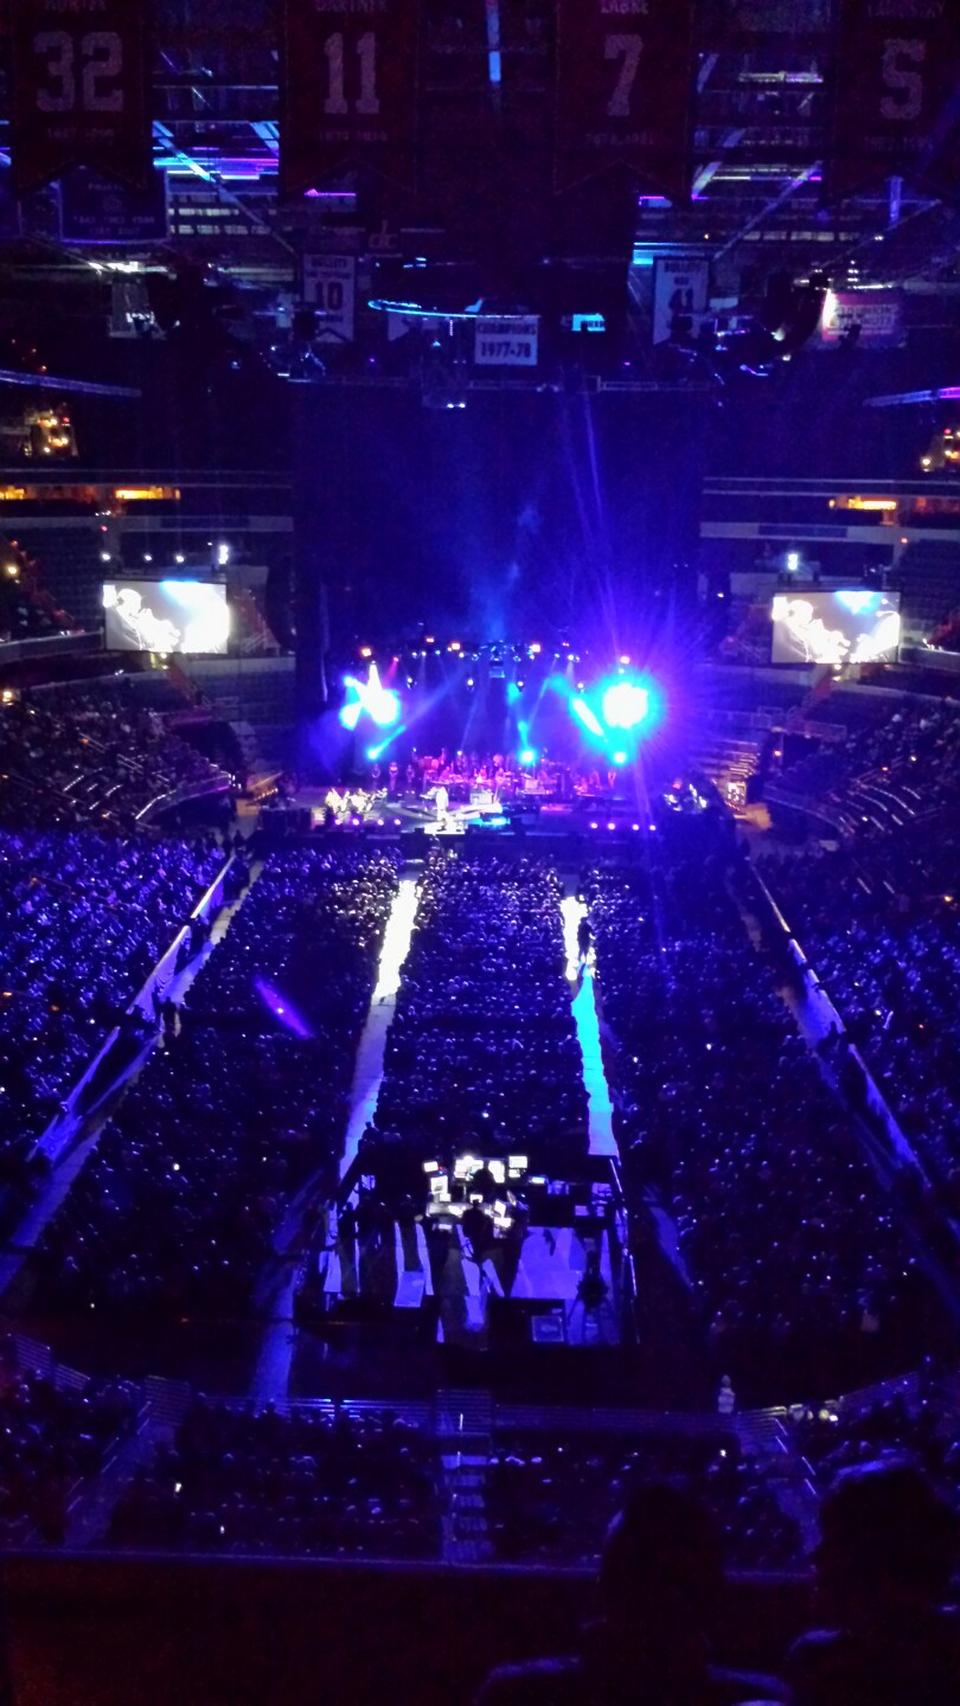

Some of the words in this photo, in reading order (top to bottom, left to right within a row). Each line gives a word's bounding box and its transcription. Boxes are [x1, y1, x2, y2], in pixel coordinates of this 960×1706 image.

[33, 31, 124, 112] 32
[323, 32, 380, 114] 11
[603, 34, 644, 117] 7
[880, 38, 926, 120] 5
[315, 281, 343, 311] 10
[481, 341, 532, 358] 1977-78
